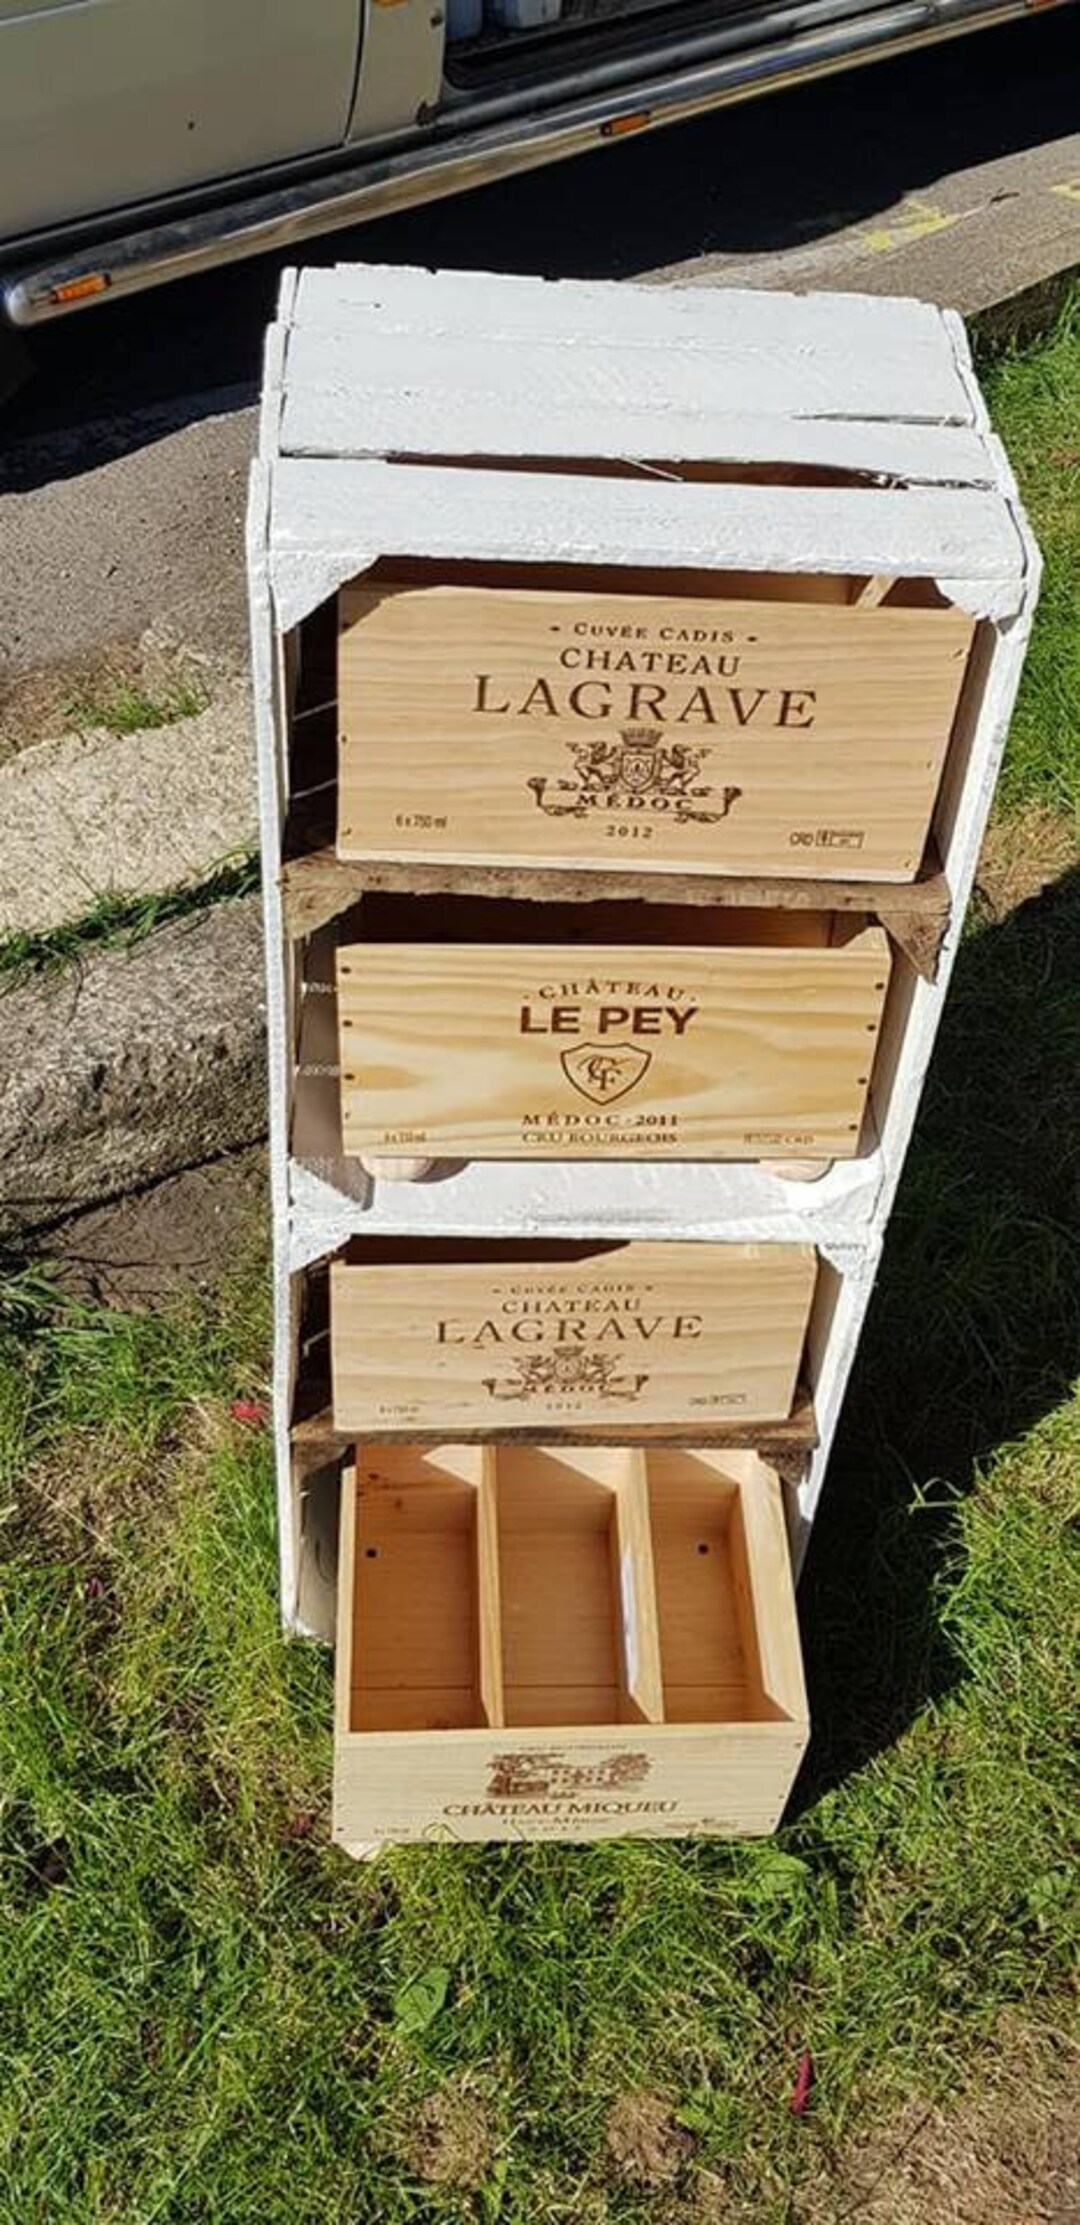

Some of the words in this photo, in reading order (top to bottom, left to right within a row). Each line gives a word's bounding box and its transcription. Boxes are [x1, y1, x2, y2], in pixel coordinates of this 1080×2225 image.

[574, 622, 648, 639] CUVÉE
[659, 627, 735, 644] CADIS
[560, 648, 741, 677] CHATEAU
[472, 674, 817, 729] LAGRAVE
[576, 793, 694, 811] MÉDOC
[605, 825, 653, 839] 2012
[539, 978, 685, 1001] CHÂTEAU
[520, 1006, 581, 1034] LE
[598, 1006, 699, 1034] PEY
[522, 1111, 620, 1127] MÉDOC
[635, 1114, 678, 1127] 2011
[502, 1298, 641, 1315] CHATEAU
[437, 1315, 703, 1344] LAGRAVE
[442, 1802, 561, 1816] CHÂTEAU
[568, 1801, 679, 1815] MIQUEU
